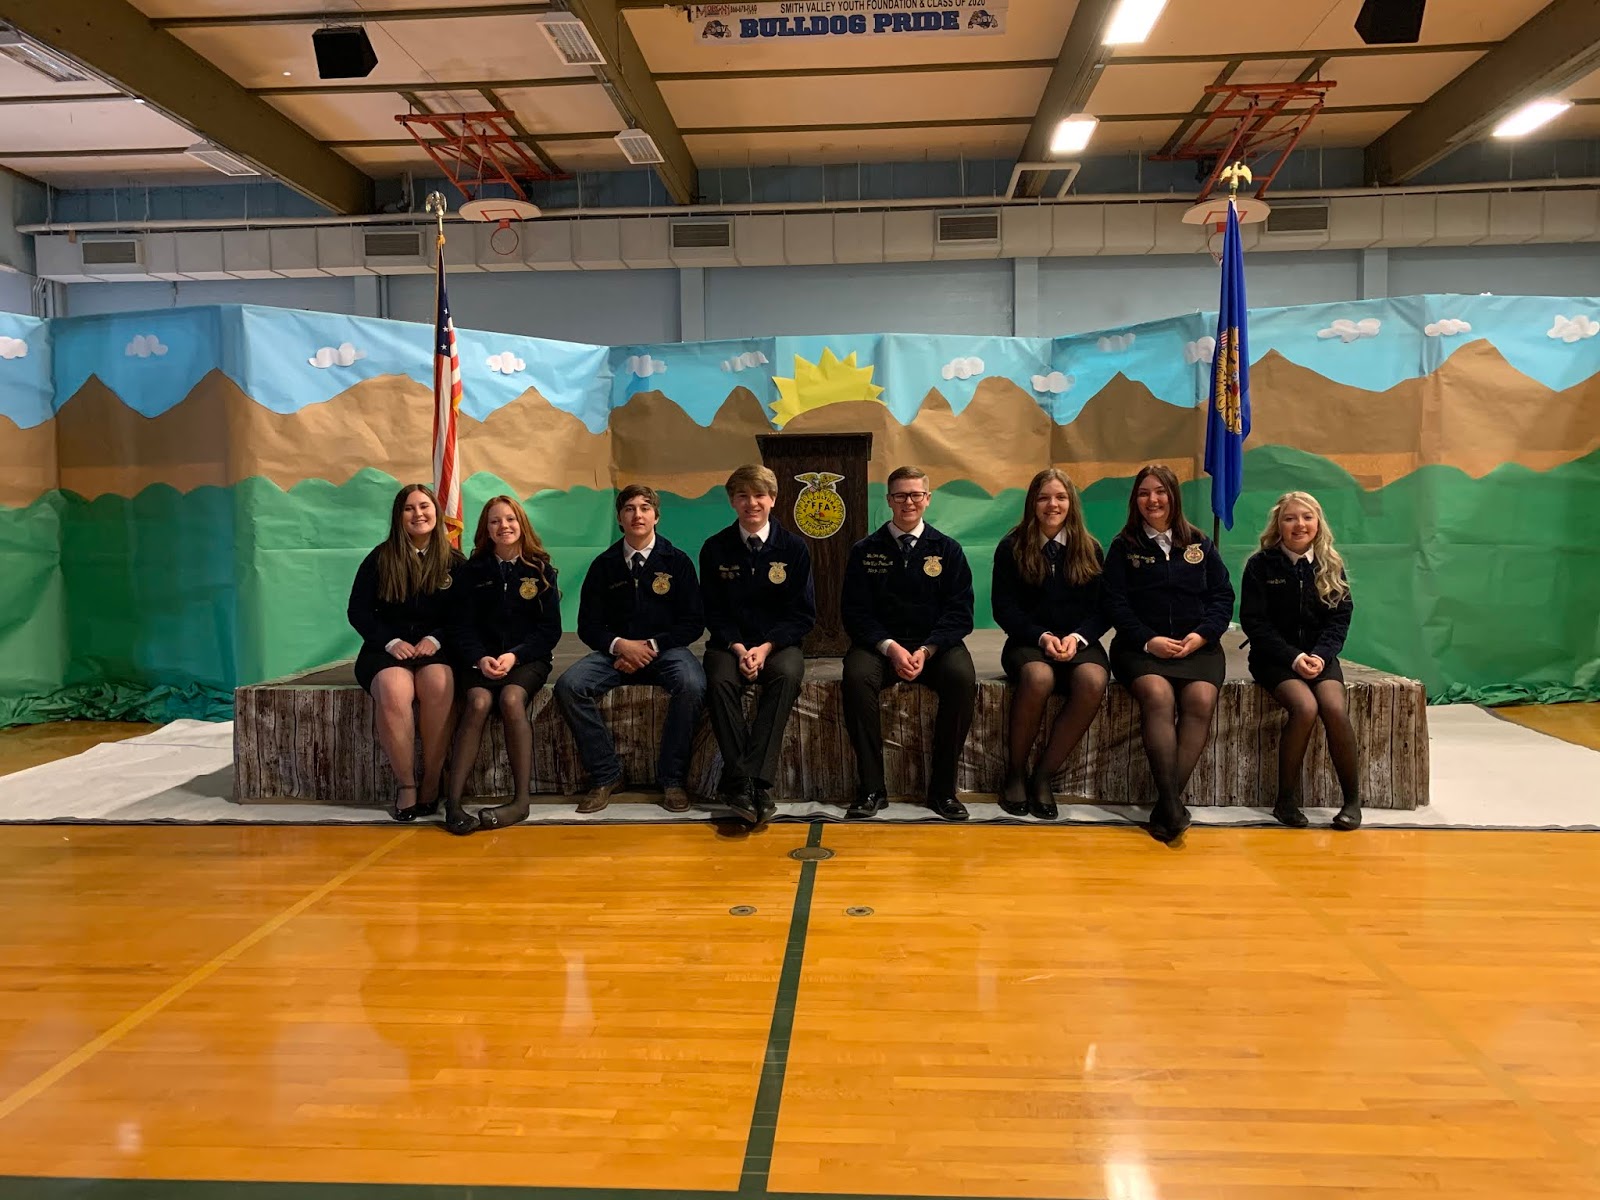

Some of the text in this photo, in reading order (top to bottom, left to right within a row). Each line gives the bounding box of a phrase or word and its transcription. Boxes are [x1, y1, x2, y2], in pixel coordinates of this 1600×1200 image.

[780, 3, 806, 13] SMITH
[807, 2, 836, 12] VALLEY
[838, 1, 864, 11] YOUTH
[866, 0, 918, 10] FOUNDATION
[919, 0, 925, 8] &
[739, 11, 960, 38] BULLDOG PRIDE
[811, 502, 830, 511] FFA
